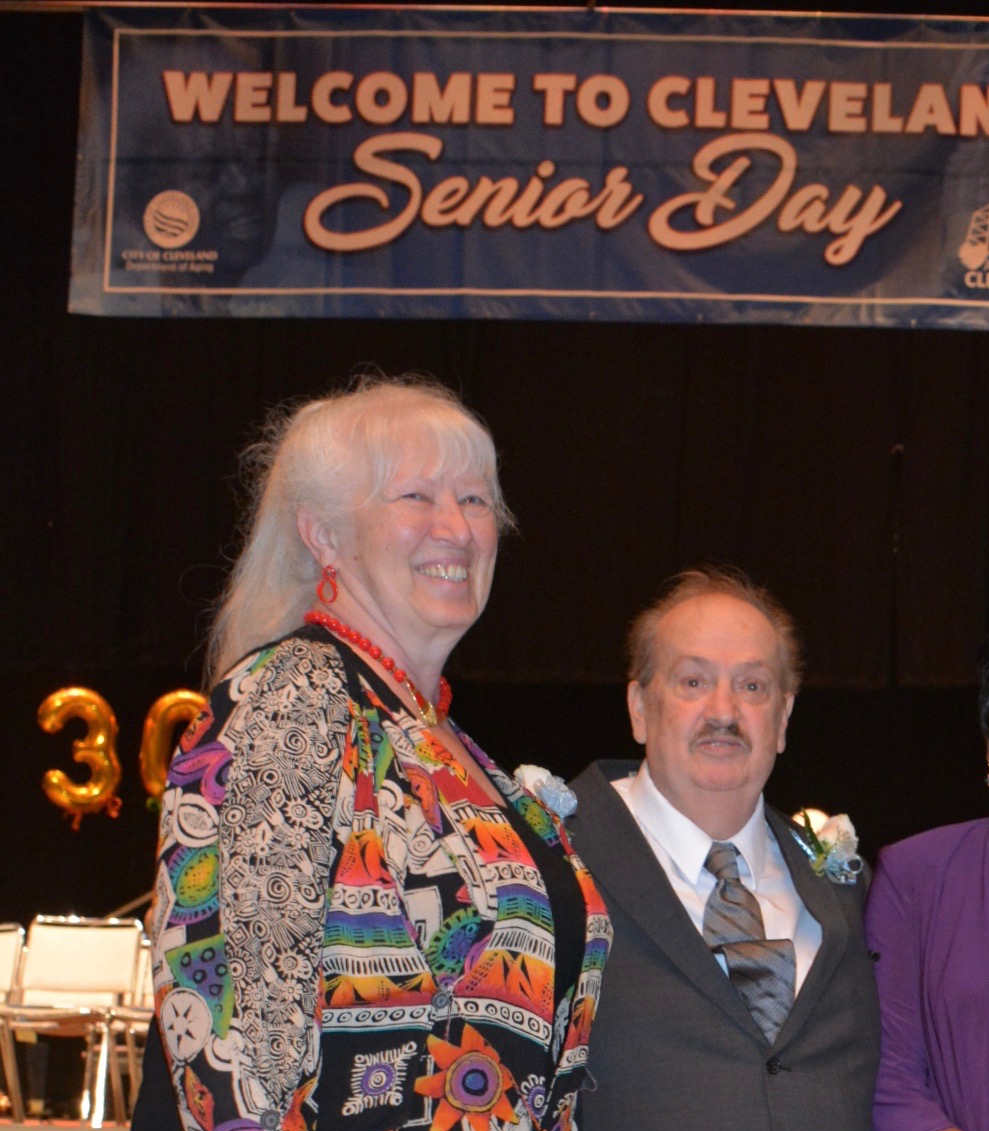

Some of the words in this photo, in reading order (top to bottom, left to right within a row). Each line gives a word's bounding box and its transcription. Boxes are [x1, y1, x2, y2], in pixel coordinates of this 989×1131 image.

[162, 70, 516, 125] WELCOME
[533, 73, 630, 128] TO
[304, 132, 643, 252] Senior
[648, 132, 902, 266] Day
